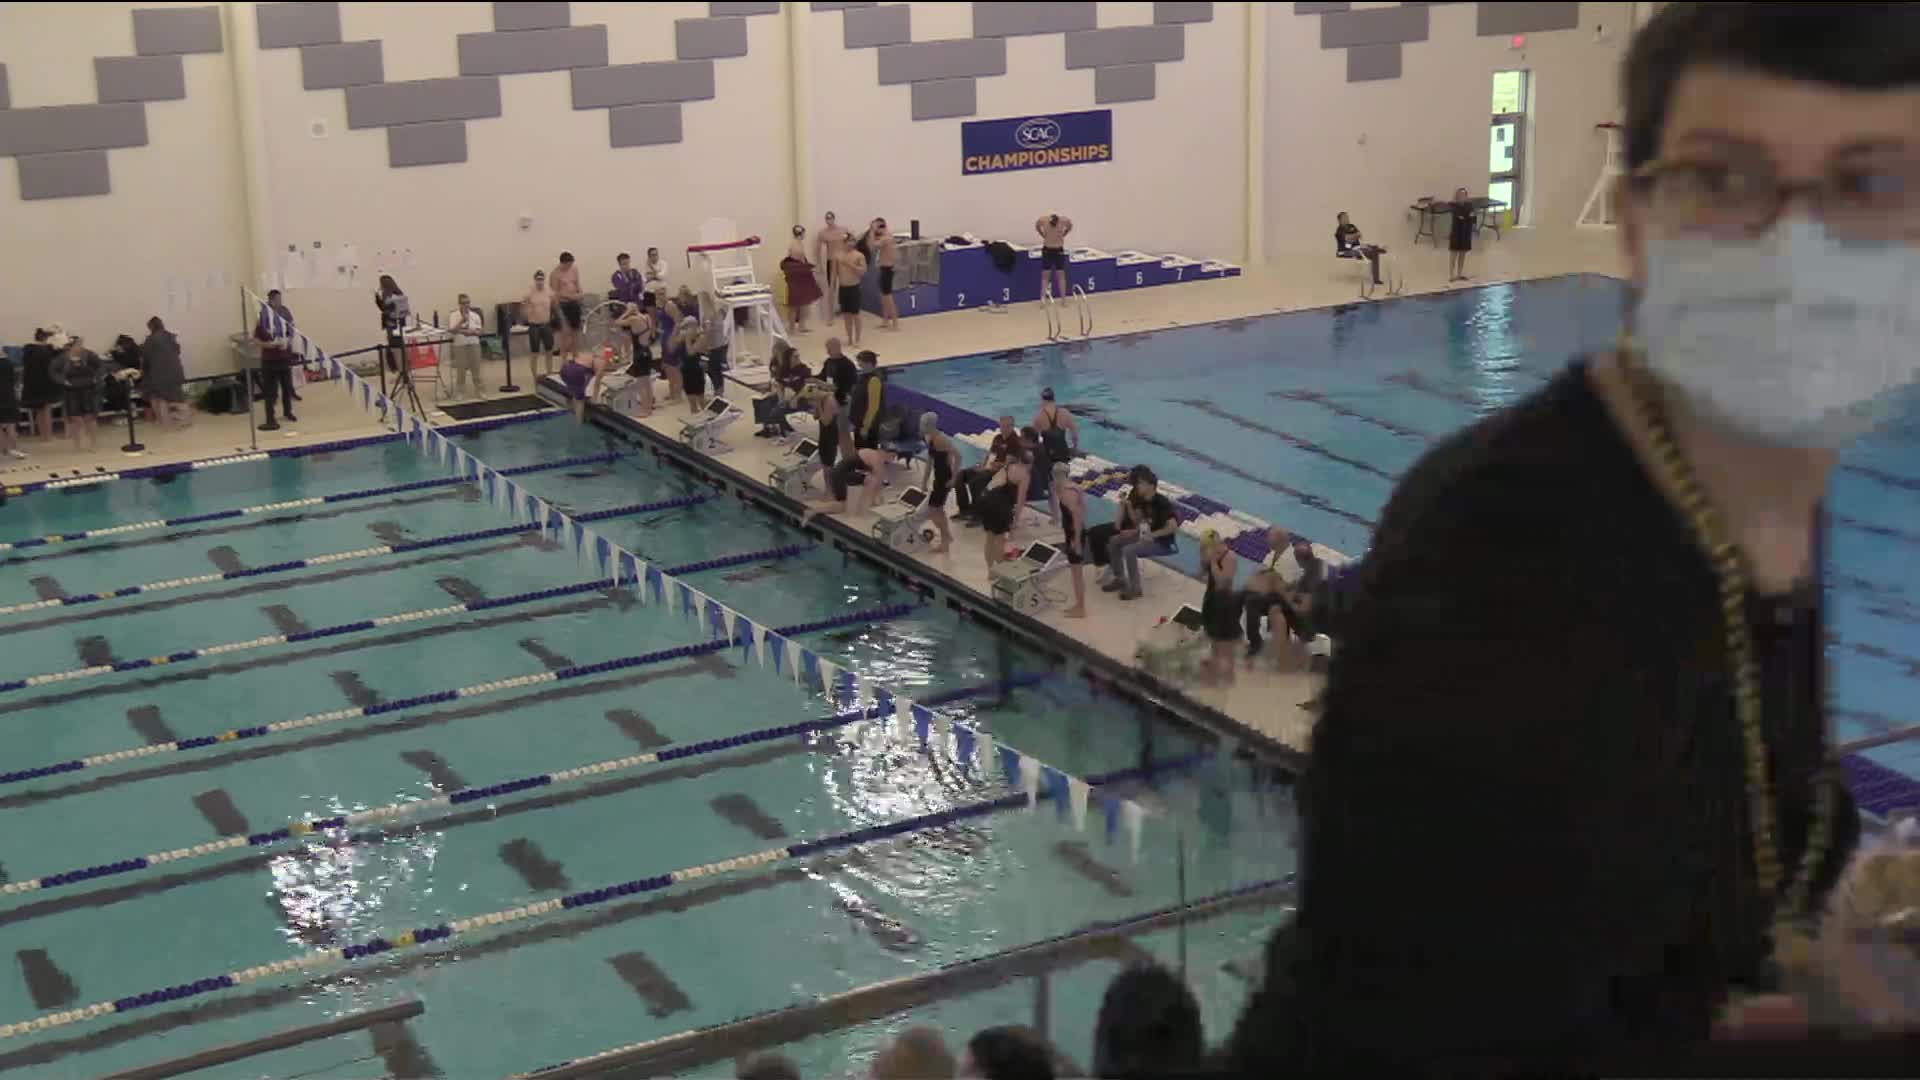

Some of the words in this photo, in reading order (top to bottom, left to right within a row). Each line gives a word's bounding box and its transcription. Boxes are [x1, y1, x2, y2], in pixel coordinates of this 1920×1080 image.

[1022, 125, 1055, 142] SCAC
[965, 144, 1110, 172] CHAMPIONSHIPS
[1135, 271, 1144, 285] 6
[1176, 268, 1184, 281] 7
[1088, 277, 1096, 290] 5
[909, 294, 917, 309] 1
[957, 292, 967, 307] 2
[1002, 287, 1011, 302] 3
[1031, 593, 1040, 608] 5
